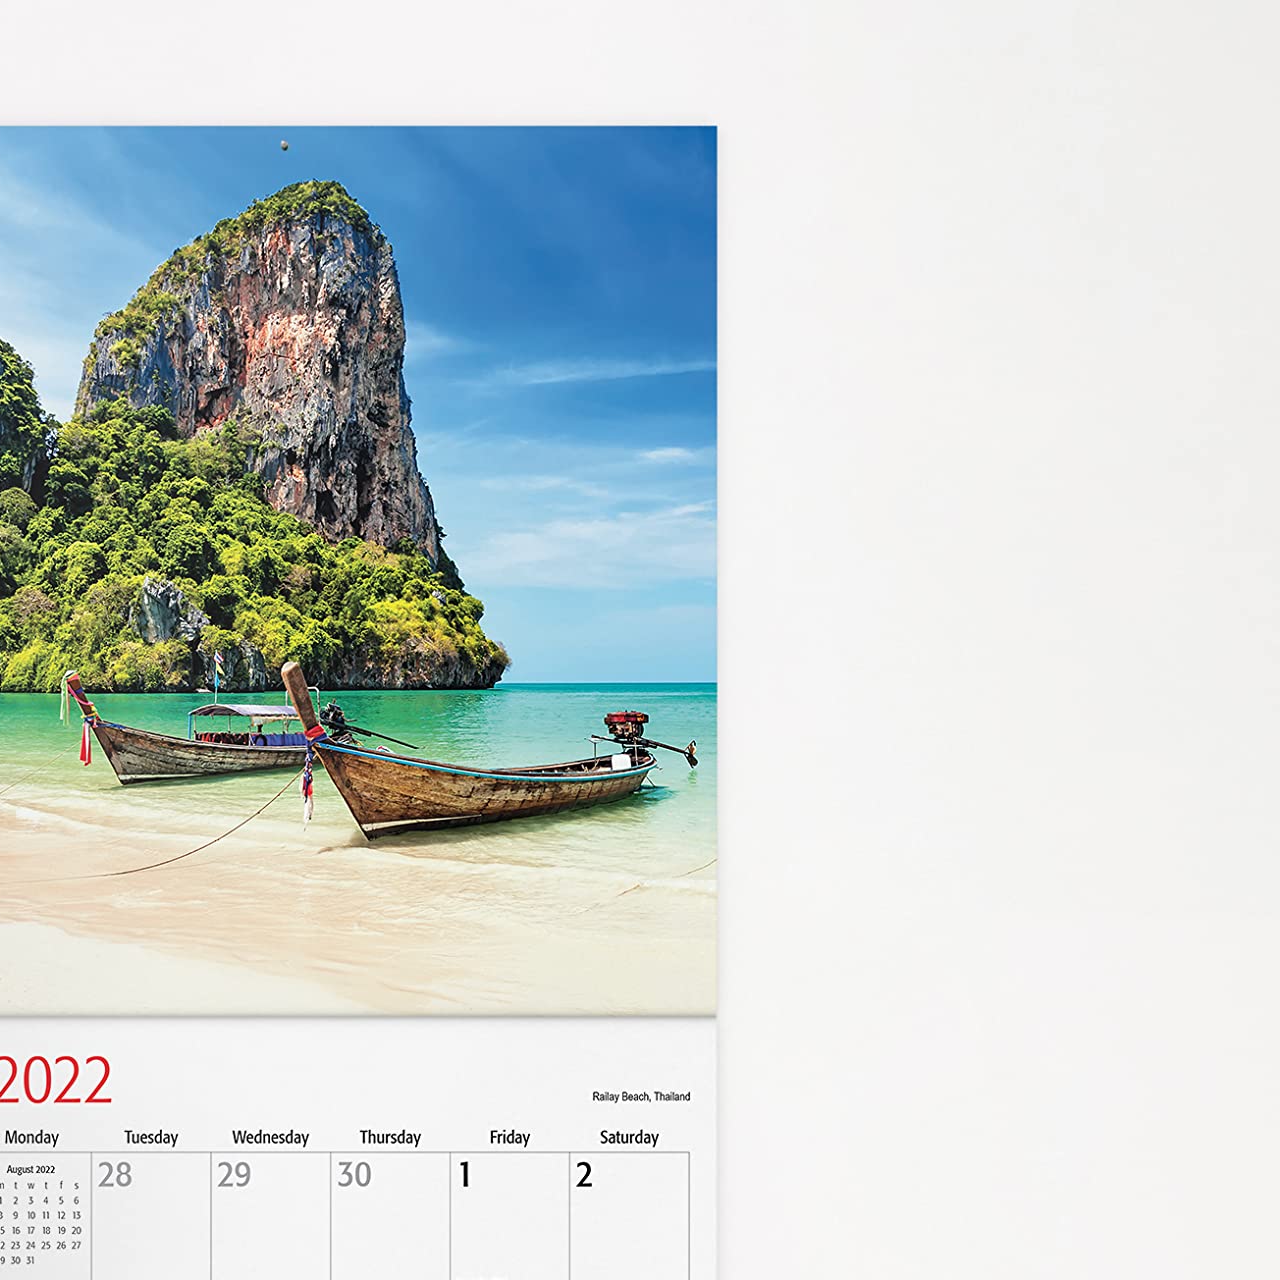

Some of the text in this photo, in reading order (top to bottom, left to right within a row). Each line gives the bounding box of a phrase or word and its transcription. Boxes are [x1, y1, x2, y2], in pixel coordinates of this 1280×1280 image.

[592, 1090, 691, 1104] Railay Beach, Thailand
[4, 1129, 60, 1148] Monday
[123, 1129, 179, 1148] Tuesday
[231, 1129, 310, 1148] Wednesday
[359, 1129, 422, 1148] Thursday
[490, 1129, 531, 1148] Friday
[600, 1128, 660, 1148] Saturday
[6, 1164, 56, 1177] August 2022
[99, 1162, 131, 1187] 28
[218, 1162, 250, 1187] 29
[338, 1162, 371, 1187] 30
[460, 1162, 468, 1187] 1
[576, 1162, 592, 1187] 2
[0, 1195, 80, 1206] 1 2 3 4 5 6
[12, 1210, 19, 1220] 9
[27, 1210, 37, 1220] 10
[42, 1210, 50, 1220] 11
[57, 1210, 66, 1220] 12
[72, 1210, 82, 1220] 13
[11, 1226, 21, 1235] 16
[27, 1225, 36, 1235] 17
[42, 1226, 51, 1235] 18
[57, 1226, 67, 1235] 19
[71, 1225, 82, 1235] 20
[10, 1240, 21, 1250] 23
[25, 1240, 36, 1250] 24
[40, 1240, 52, 1250] 25
[56, 1240, 67, 1250] 26
[71, 1240, 82, 1250] 27
[10, 1255, 22, 1265] 30
[26, 1255, 35, 1265] 31
